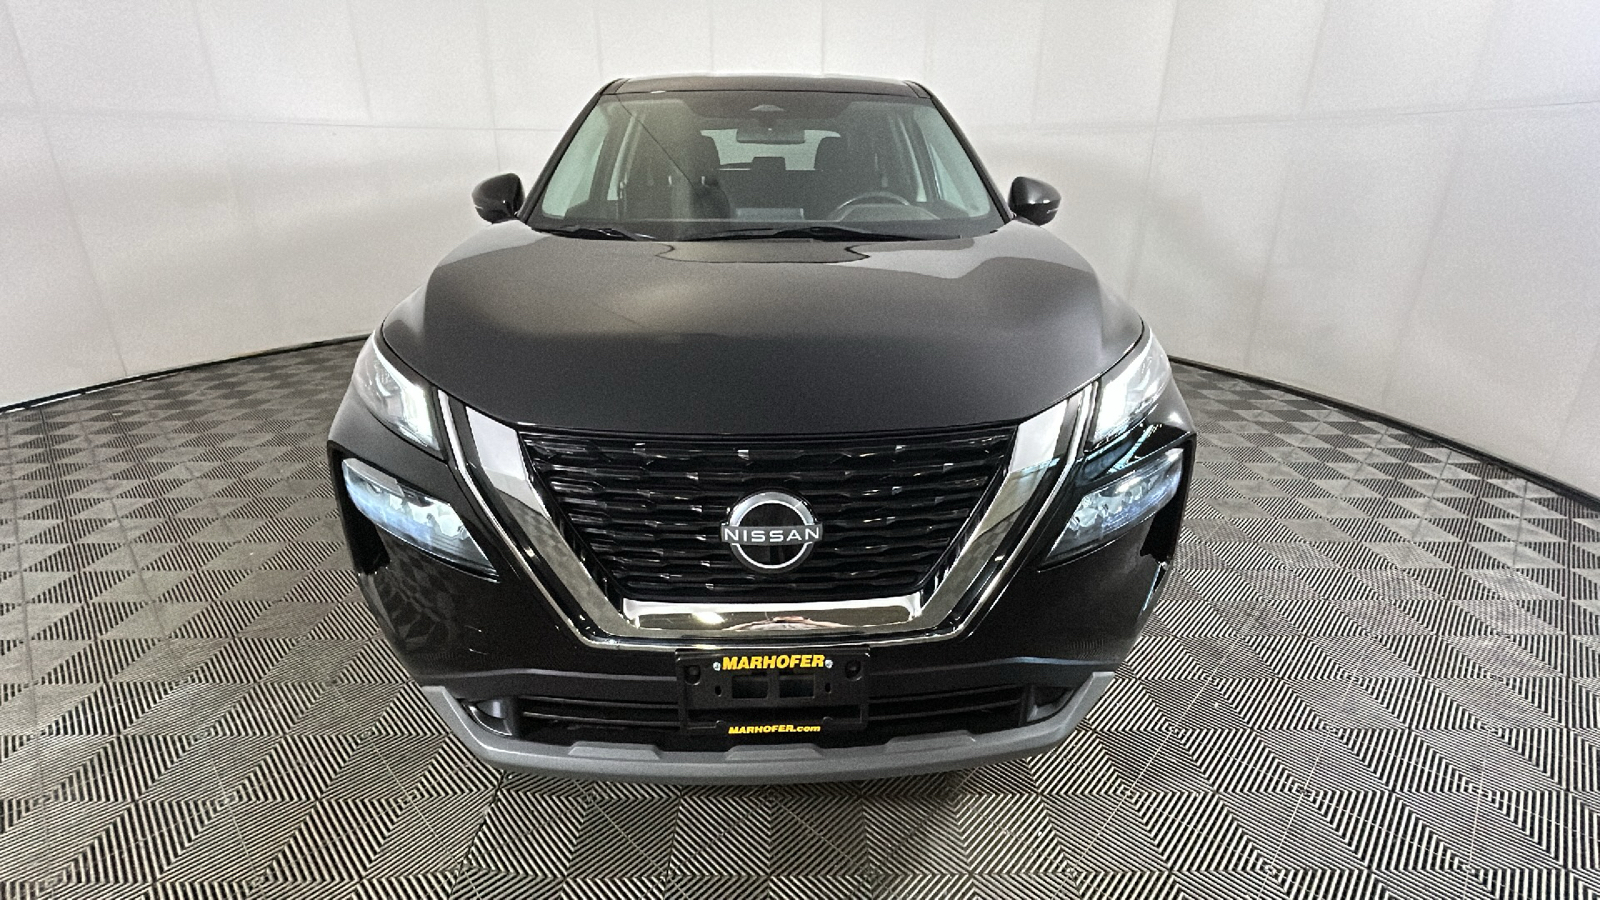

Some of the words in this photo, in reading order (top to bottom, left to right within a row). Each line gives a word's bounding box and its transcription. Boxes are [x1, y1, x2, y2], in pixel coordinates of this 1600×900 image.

[724, 527, 820, 542] NISSAN
[722, 655, 825, 670] MARHOFER
[728, 724, 821, 734] MARHOFER.com
